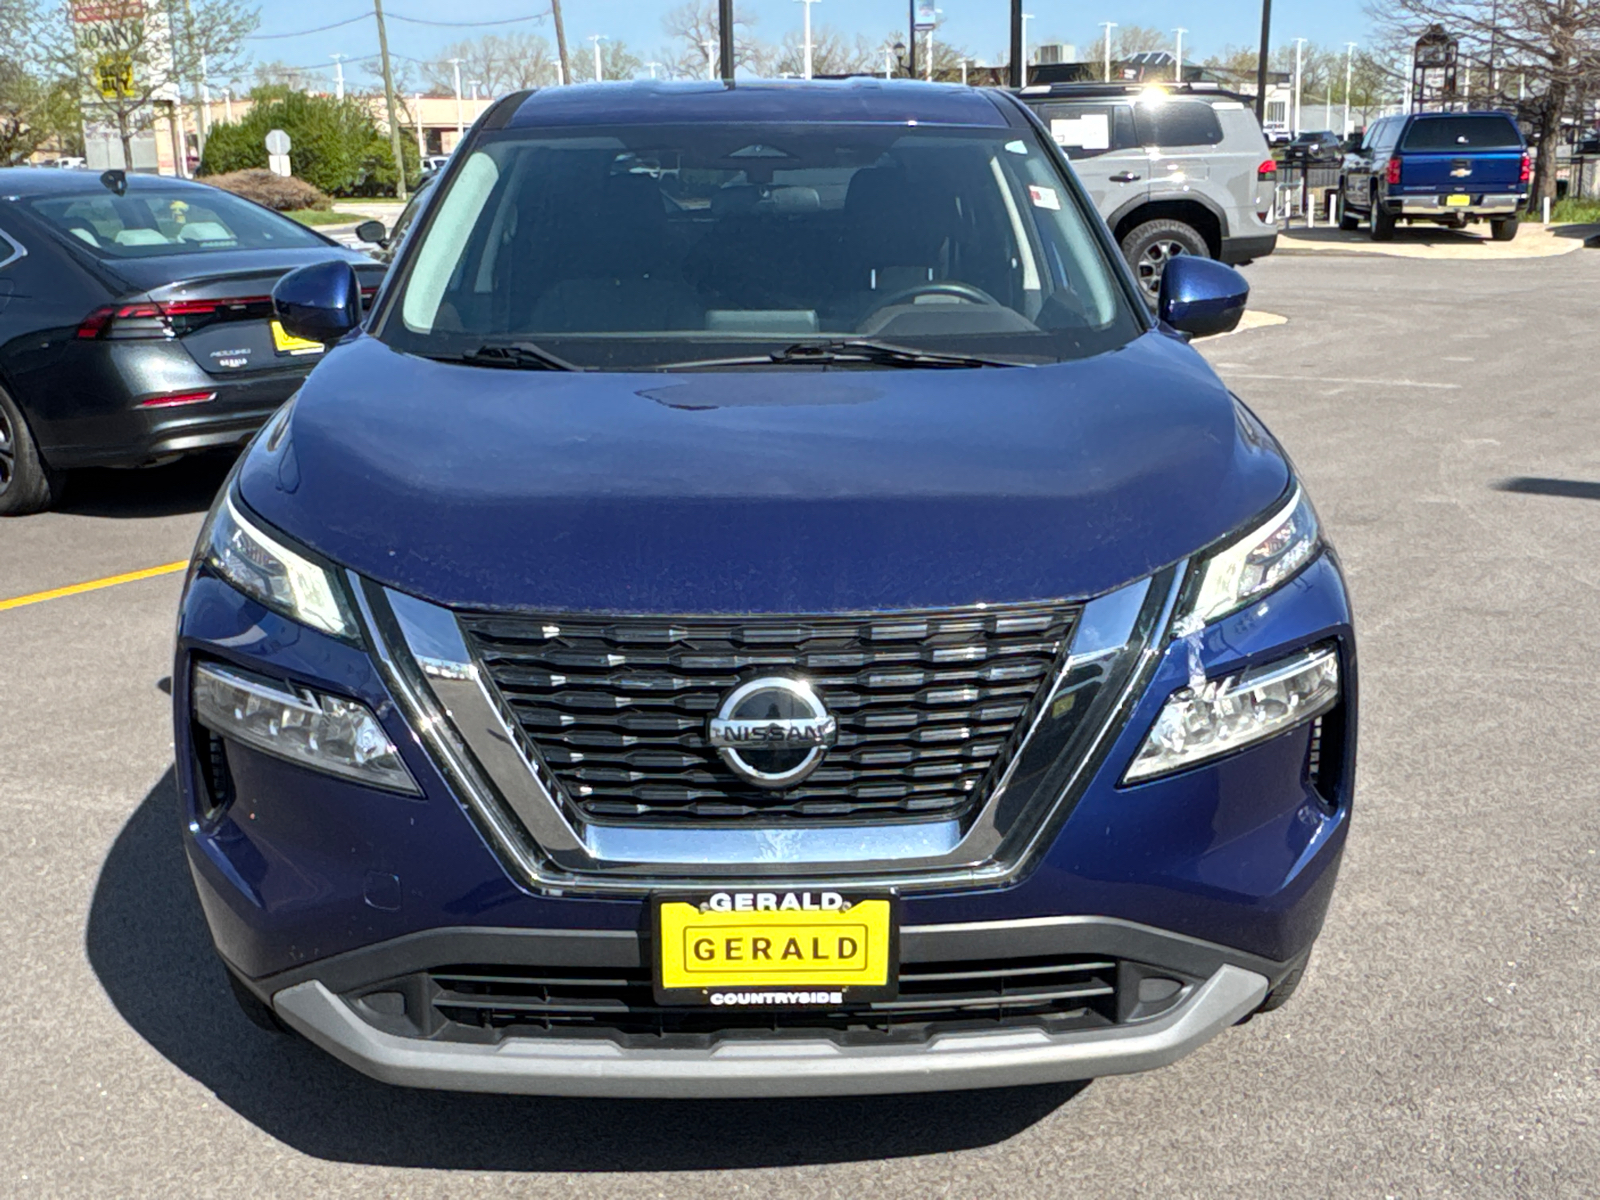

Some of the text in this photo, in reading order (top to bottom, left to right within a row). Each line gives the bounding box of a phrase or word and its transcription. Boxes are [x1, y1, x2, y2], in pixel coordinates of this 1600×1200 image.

[724, 724, 822, 741] NISSAN
[709, 892, 843, 912] GERALD
[693, 937, 858, 961] GERALD
[710, 991, 843, 1005] COUNTRYSIDE
